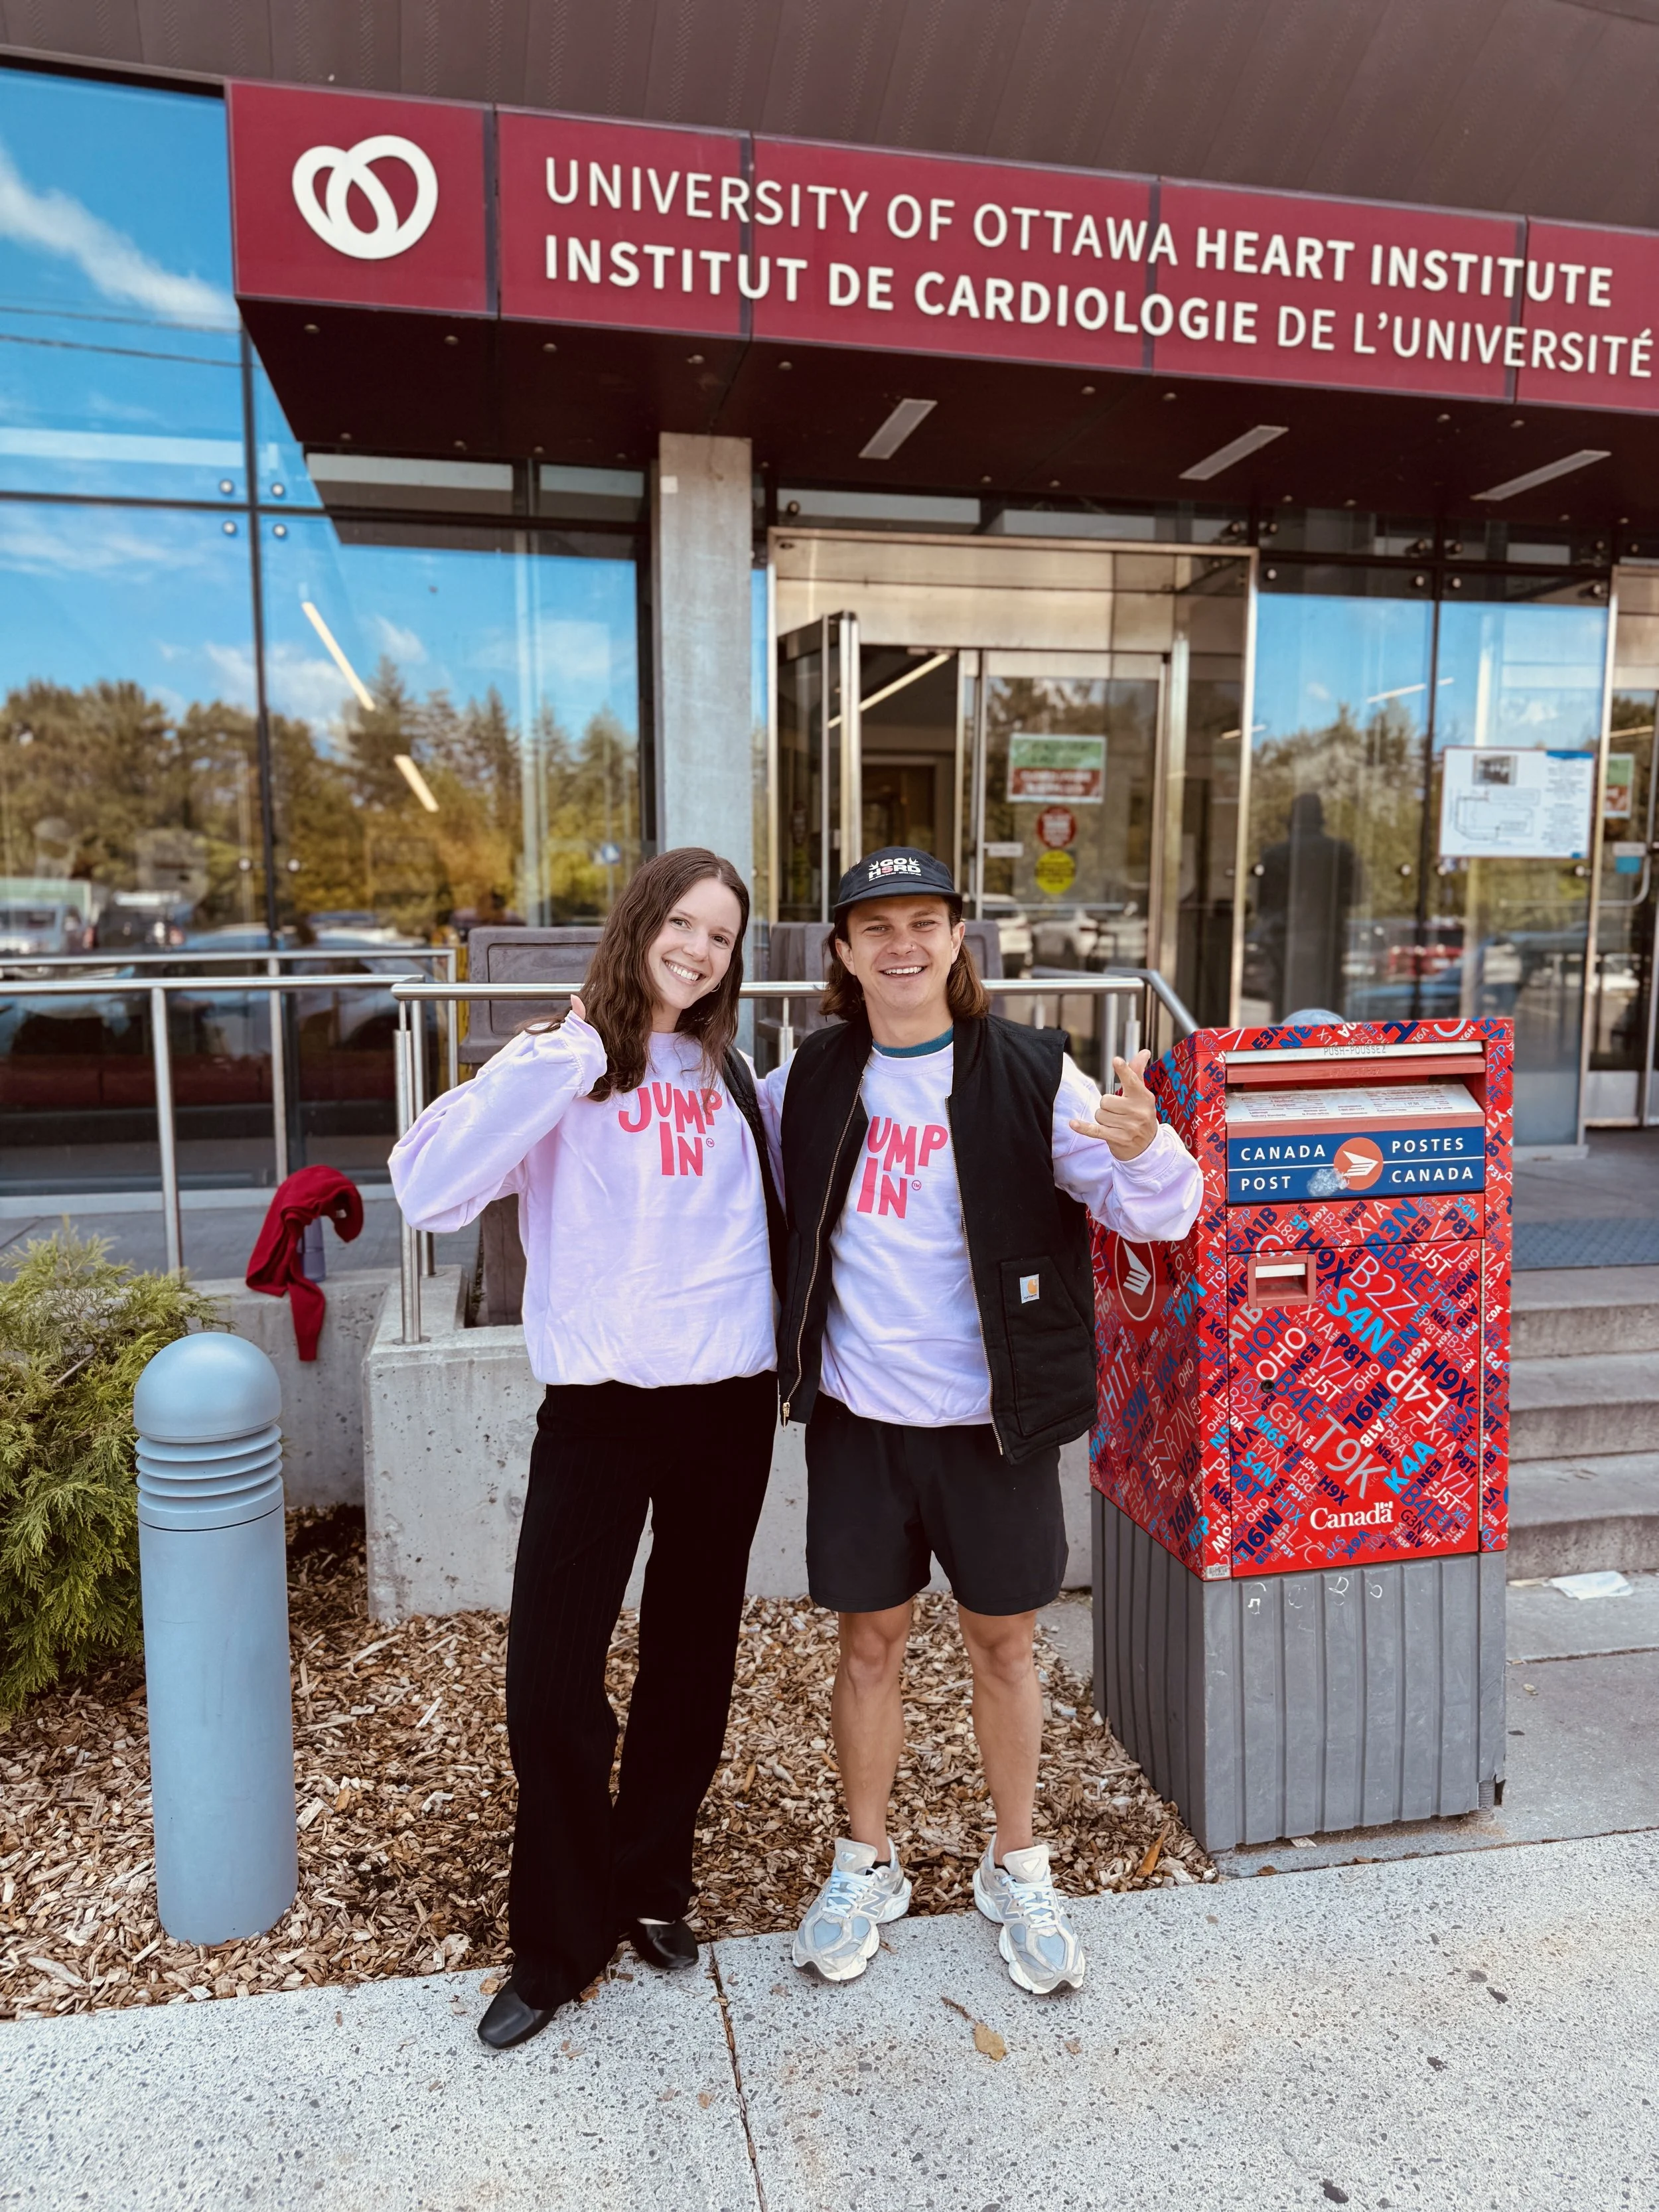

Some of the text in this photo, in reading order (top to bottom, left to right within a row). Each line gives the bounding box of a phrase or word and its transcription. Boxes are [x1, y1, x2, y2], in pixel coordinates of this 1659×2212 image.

[546, 157, 1613, 308] UNIVERSITY OF OTTAWA HEART INSTITUTE
[545, 234, 1654, 379] INSTITUT DE CARDIOLOGIE DE L'UNIVERSITÉ
[880, 857, 907, 867] GO
[1324, 1045, 1387, 1055] PUSH-POUSSEZ
[618, 1082, 723, 1134] JUMP
[660, 1122, 704, 1177] IN
[867, 1116, 949, 1175] UMP
[1241, 1144, 1326, 1161] CANADA
[1392, 1138, 1464, 1153] POSTES
[857, 1157, 908, 1219] IN
[1204, 1169, 1218, 1182] Y1A
[1241, 1176, 1291, 1191] POST
[1392, 1167, 1473, 1183] CANADA
[1232, 1209, 1251, 1231] S7P
[1298, 1204, 1311, 1218] V5A
[1309, 1205, 1329, 1226] K6H
[1344, 1201, 1367, 1225] E3N
[1351, 1201, 1390, 1239] X1A
[1415, 1197, 1436, 1217] G5N
[1438, 1199, 1453, 1217] M3C
[1454, 1197, 1479, 1222] S4N
[1244, 1207, 1277, 1246] A1B
[1273, 1219, 1299, 1244] P8T
[1323, 1211, 1350, 1240] B2Z
[1364, 1199, 1420, 1259] B3N
[1401, 1215, 1432, 1250] E3N
[1442, 1208, 1478, 1241] P8T
[1226, 1228, 1253, 1264] V5A
[1429, 1219, 1469, 1264] V7J
[1204, 1265, 1215, 1277] G1P
[1295, 1228, 1354, 1289] H9X
[1382, 1245, 1434, 1296] B4E
[1419, 1248, 1452, 1276] J5T
[1315, 1284, 1333, 1306] S7P
[1348, 1256, 1419, 1326] B2Z
[1448, 1268, 1479, 1300] M9L
[1174, 1274, 1207, 1327] K4A
[1205, 1293, 1220, 1312] S7P
[1432, 1288, 1461, 1321] T9K
[1458, 1288, 1478, 1310] B2J
[1299, 1304, 1334, 1340] X1A
[1326, 1288, 1395, 1355] S4N
[1419, 1317, 1443, 1340] P8T
[1457, 1301, 1478, 1328] A1B
[1435, 1329, 1453, 1348] K6H
[1461, 1321, 1479, 1342] P3Y
[1290, 1341, 1322, 1375] E3N
[1333, 1333, 1371, 1369] P8T
[1377, 1323, 1421, 1370] B3N
[1402, 1337, 1431, 1369] K6H
[1447, 1335, 1474, 1362] B2Z
[1207, 1368, 1222, 1381] Y1A
[1297, 1366, 1319, 1386] Y1A
[1319, 1346, 1360, 1390] V7J
[1419, 1349, 1477, 1409] H9X
[1102, 1347, 1131, 1420] H1T
[1273, 1369, 1325, 1423] B4E
[1309, 1374, 1343, 1402] J5T
[1386, 1366, 1450, 1424] E4P
[1261, 1394, 1277, 1411] R2P
[1342, 1380, 1392, 1430] M9L
[1378, 1396, 1398, 1420] N5P
[1438, 1404, 1456, 1427] S7P
[1253, 1414, 1289, 1449] M6S
[1269, 1402, 1310, 1442] G3N
[1360, 1418, 1385, 1447] A1B
[1385, 1417, 1400, 1431] P3Y
[1392, 1403, 1427, 1438] L7C
[1446, 1405, 1479, 1438] V6K
[1456, 1425, 1477, 1445] V1X
[1228, 1426, 1260, 1462] V1X
[1252, 1437, 1287, 1471] R7N
[1380, 1429, 1407, 1458] P9A
[1402, 1434, 1414, 1446] B2J
[1424, 1422, 1457, 1459] X1A
[1178, 1441, 1202, 1480] V5A
[1240, 1451, 1278, 1487] S4N
[1310, 1412, 1388, 1500] T9K
[1383, 1440, 1437, 1495] K4A
[1451, 1449, 1477, 1473] P8T
[1289, 1467, 1317, 1493] P8T
[1416, 1458, 1444, 1488] E3N
[1441, 1461, 1475, 1499] V7J
[1189, 1483, 1202, 1513] S4N
[1266, 1478, 1289, 1499] V5A
[1285, 1483, 1307, 1502] P3Y
[1317, 1475, 1350, 1507] H9X
[1423, 1480, 1441, 1498] Y1A
[1432, 1487, 1461, 1511] J5T
[1168, 1490, 1196, 1541] M9L
[1210, 1503, 1222, 1515] P9A
[1273, 1493, 1305, 1526] H1X
[1310, 1501, 1394, 1530] Canada
[1400, 1483, 1446, 1529] B4E
[1451, 1506, 1473, 1529] T9K
[1188, 1515, 1209, 1551] N5P
[1210, 1512, 1229, 1532] Y1A
[1233, 1507, 1283, 1556] M9L
[1270, 1524, 1290, 1547] N5P
[1400, 1509, 1426, 1535] G3N
[1279, 1544, 1295, 1559] P3Y
[1286, 1527, 1323, 1564] L7C
[1327, 1534, 1346, 1559] S7P
[1342, 1530, 1371, 1560] V6K
[1396, 1535, 1411, 1548] N5P
[1406, 1530, 1424, 1548] A1B
[1421, 1528, 1441, 1548] H1T
[1254, 1544, 1274, 1565] A1B
